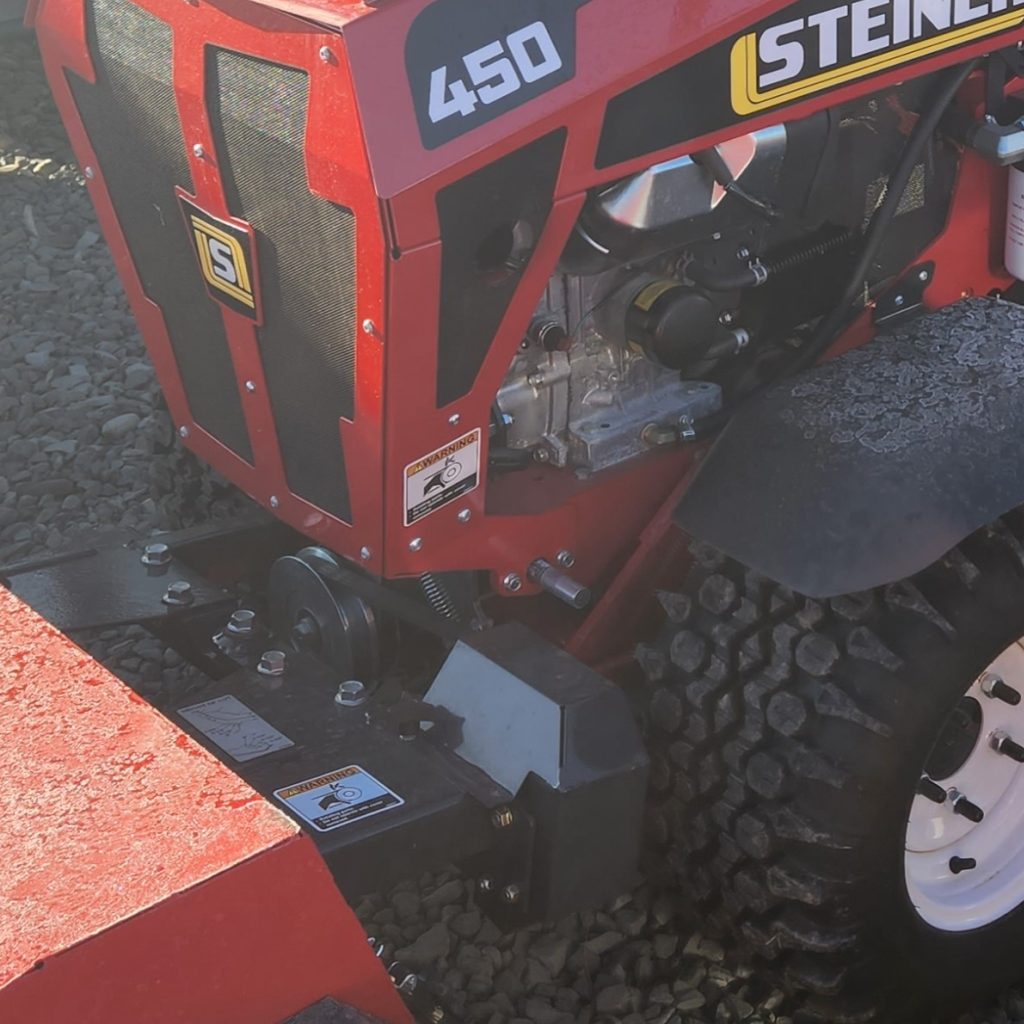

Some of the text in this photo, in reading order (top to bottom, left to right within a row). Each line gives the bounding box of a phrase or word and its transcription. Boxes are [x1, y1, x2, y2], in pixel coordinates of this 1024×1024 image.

[427, 20, 563, 124] 450
[208, 237, 237, 284] S
[422, 433, 477, 469] WARNING
[298, 768, 357, 793] WARNING
